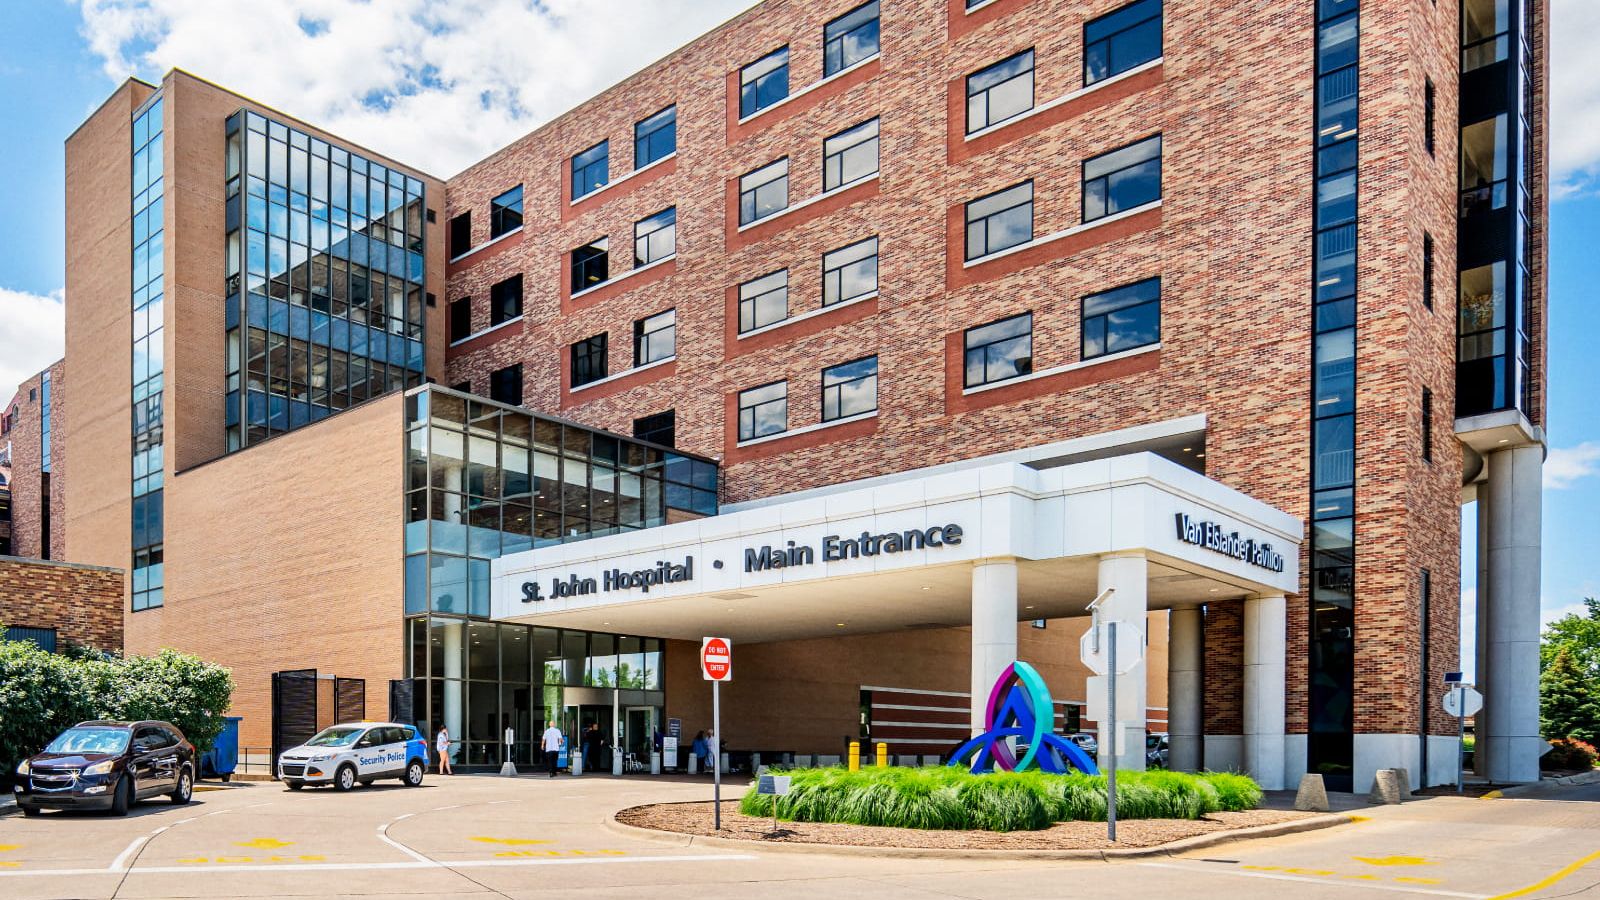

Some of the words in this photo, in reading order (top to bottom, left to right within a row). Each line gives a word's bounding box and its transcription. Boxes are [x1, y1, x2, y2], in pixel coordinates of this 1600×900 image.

[521, 581, 545, 603] St.
[549, 573, 597, 599] John
[603, 555, 694, 593] Hospital
[744, 541, 814, 573] Main
[822, 523, 963, 562] Entrance
[1176, 513, 1202, 545] Van
[1203, 521, 1250, 561] Elslander
[1251, 540, 1283, 572] Pavilion
[360, 754, 386, 765] Security
[387, 751, 405, 762] Police
